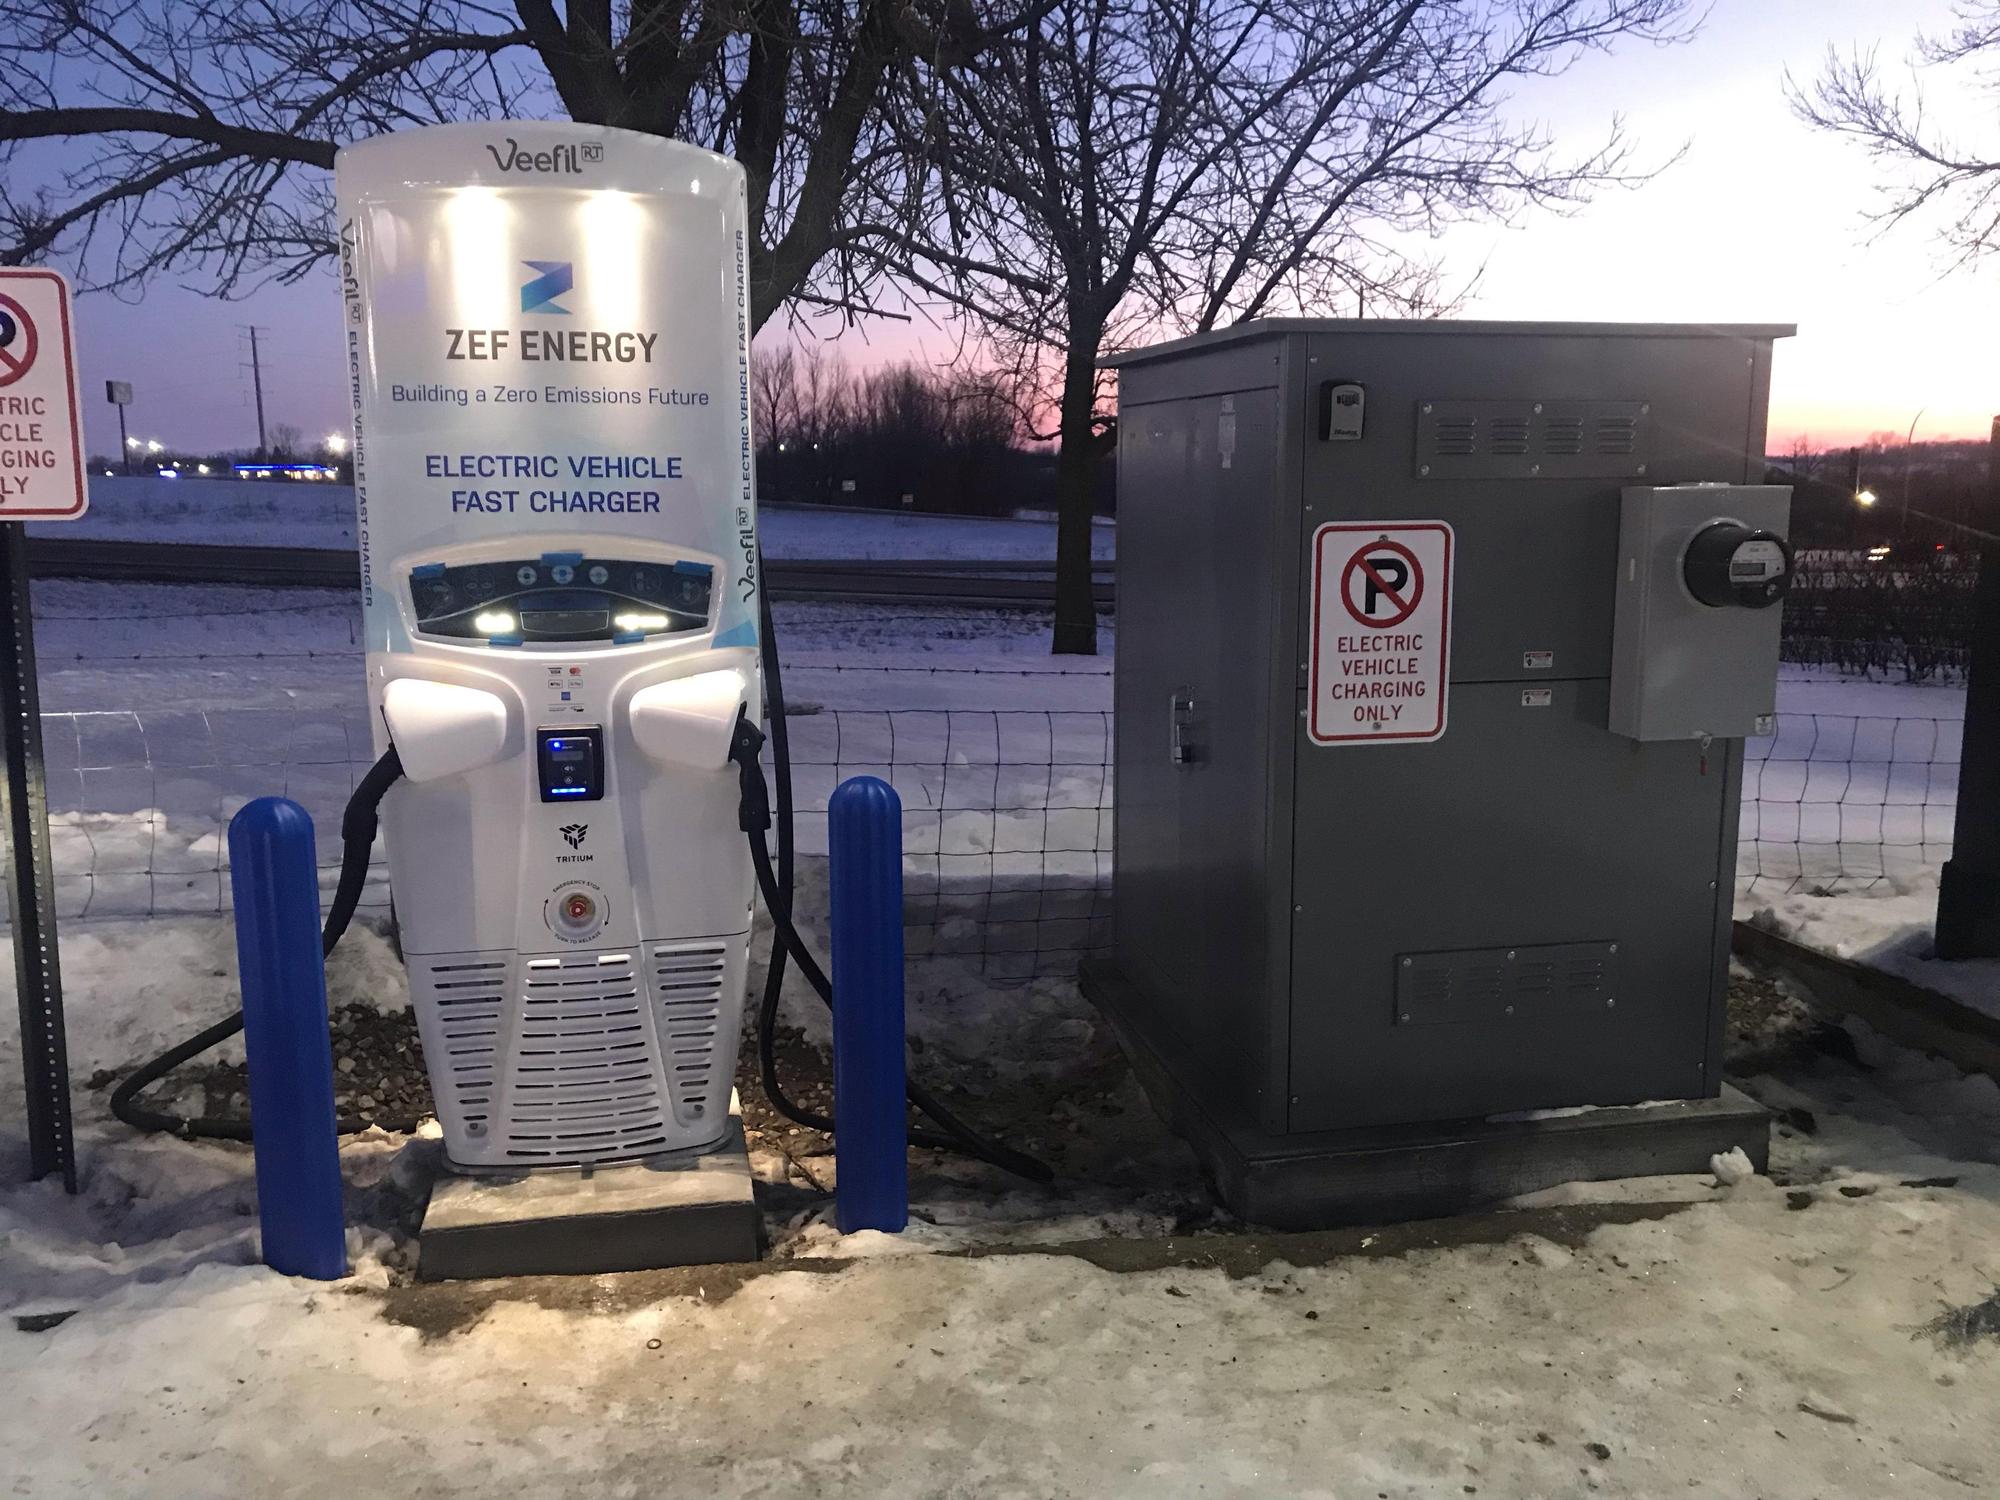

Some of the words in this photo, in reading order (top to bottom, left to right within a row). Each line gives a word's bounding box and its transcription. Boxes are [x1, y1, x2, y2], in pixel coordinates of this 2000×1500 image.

[486, 138, 583, 174] Veefil
[581, 144, 603, 161] RT
[340, 217, 359, 304] Veefil
[736, 230, 745, 308] CHARGER
[445, 329, 510, 360] ZEF
[520, 330, 659, 363] ENERGY
[738, 313, 746, 350] FAST
[349, 331, 362, 410] ELECTRIC
[739, 355, 749, 421] VEHICLE
[392, 384, 468, 406] Building
[475, 388, 487, 402] a
[493, 385, 538, 402] Zero
[544, 386, 642, 404] Emissions
[648, 387, 709, 405] Future
[353, 414, 366, 482] VEHICLE
[741, 426, 751, 500] ELECTRIC
[425, 455, 559, 477] ELECTRIC
[568, 456, 683, 478] VEHICLE
[358, 486, 368, 526] FAST
[451, 490, 520, 513] FAST
[529, 491, 661, 513] CHARGER
[361, 530, 372, 607] CHARGER
[738, 525, 756, 602] Veefil
[1337, 634, 1423, 653] ELECTRIC
[1341, 658, 1419, 676] VEHICLE
[1331, 681, 1426, 700] CHARGING
[1353, 704, 1403, 722] ONLY
[556, 855, 594, 863] TRITIUM
